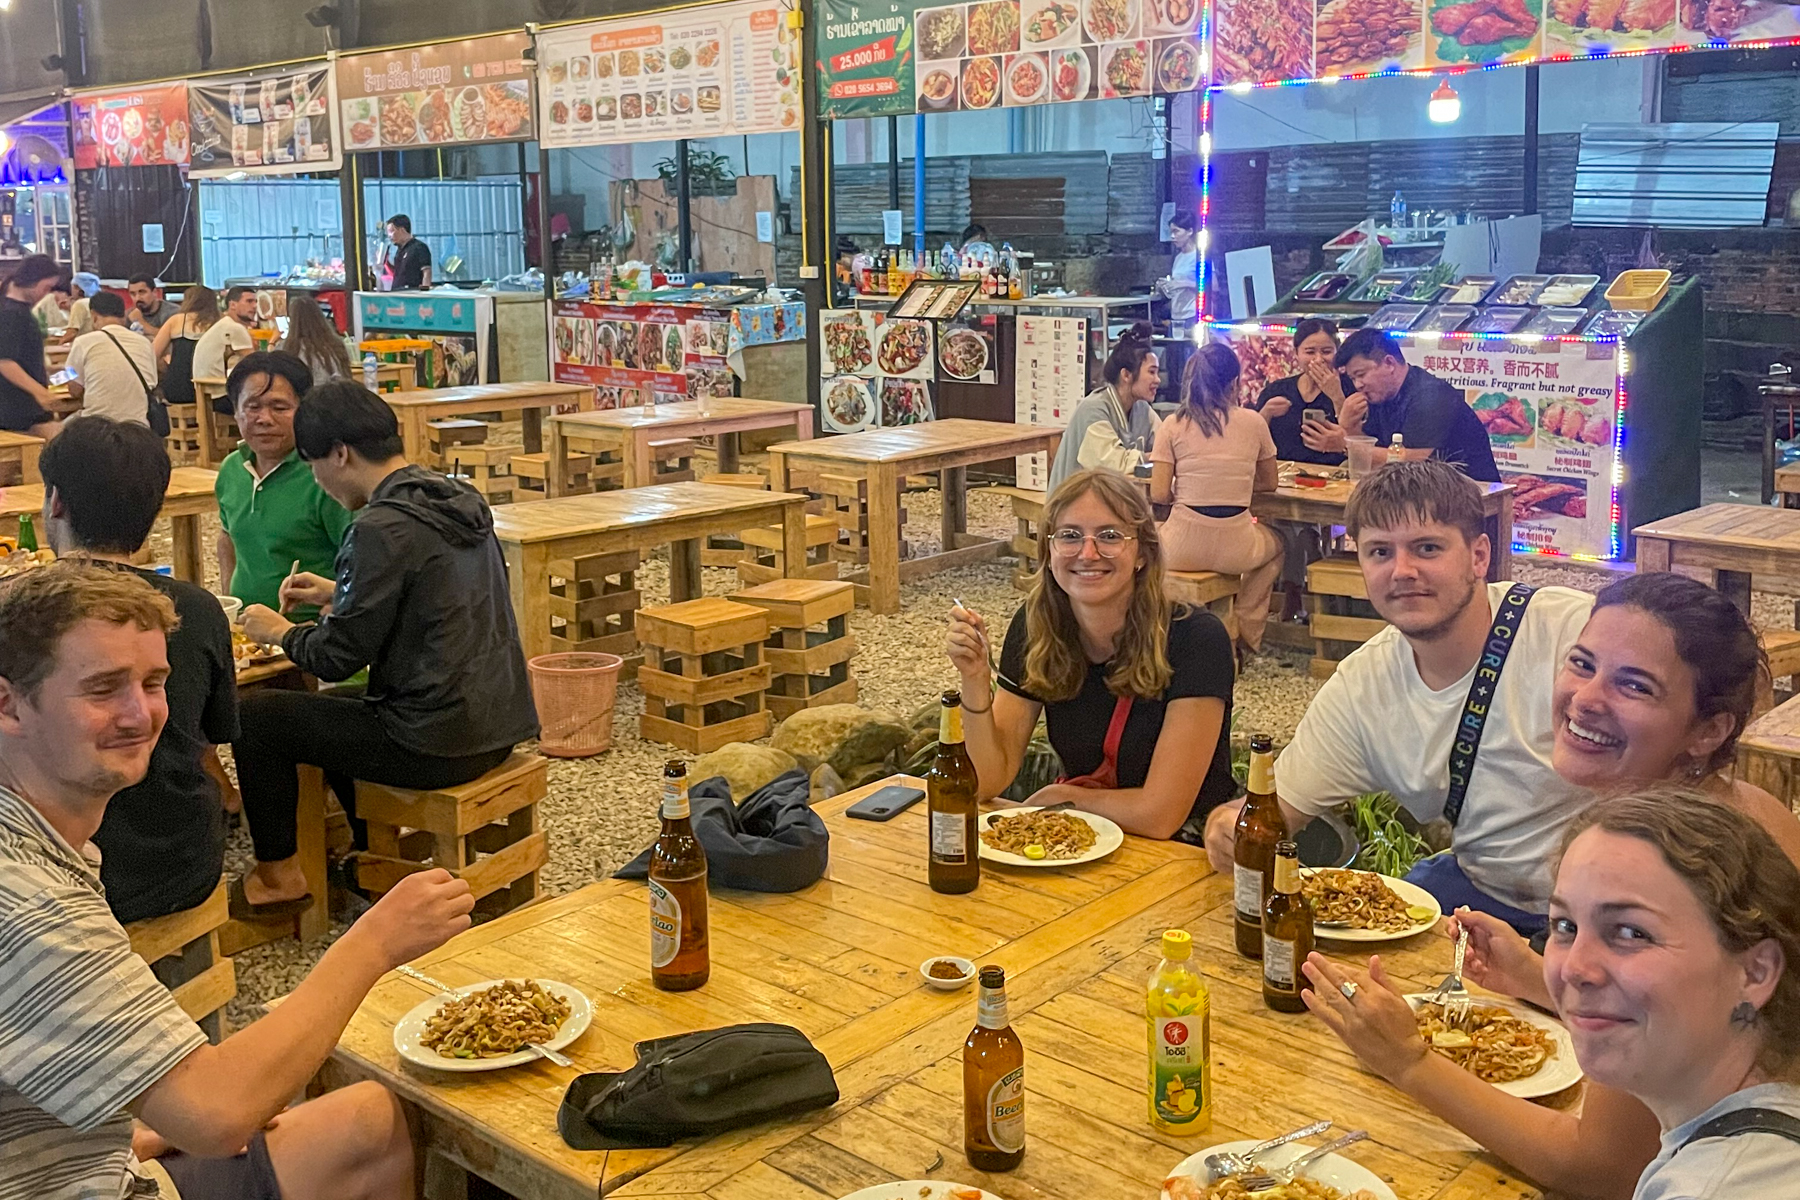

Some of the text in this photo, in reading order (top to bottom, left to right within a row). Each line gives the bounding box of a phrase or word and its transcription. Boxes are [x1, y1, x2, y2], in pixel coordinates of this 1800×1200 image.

[840, 50, 872, 70] 25.000
[1490, 377, 1537, 392] Fragrant
[1539, 380, 1556, 392] but
[1558, 382, 1575, 393] not
[1578, 385, 1613, 399] greasy
[1479, 625, 1512, 682] CURE
[1457, 700, 1487, 756] CURE
[996, 1101, 1023, 1117] Beer
